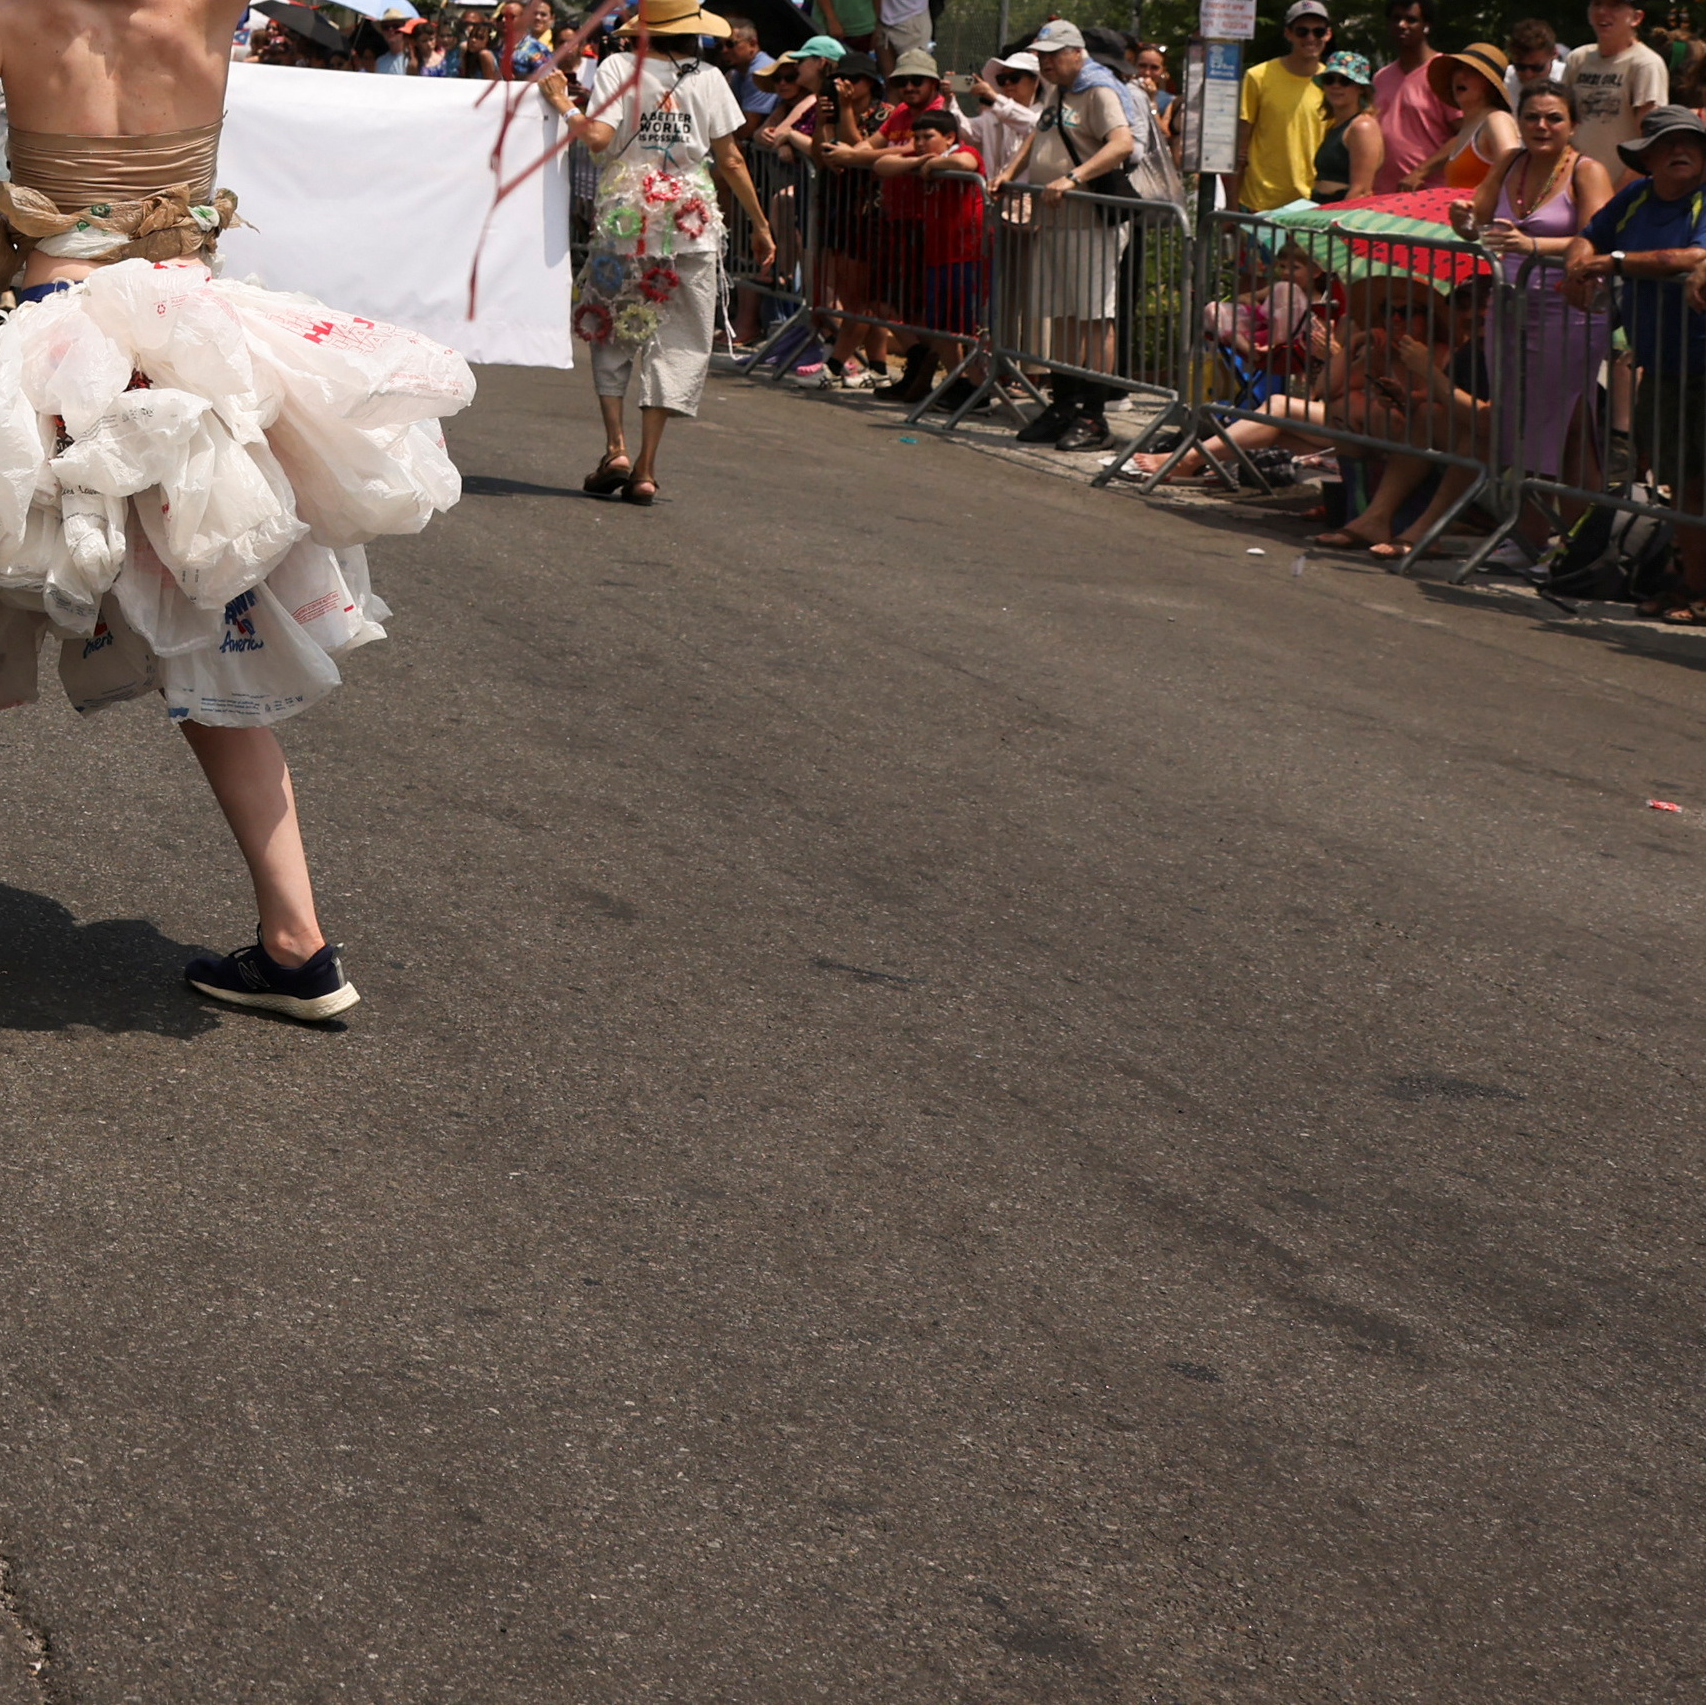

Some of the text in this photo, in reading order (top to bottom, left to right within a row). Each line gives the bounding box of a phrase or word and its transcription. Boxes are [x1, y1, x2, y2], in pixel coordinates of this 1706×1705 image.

[650, 111, 691, 123] BETTER
[640, 123, 691, 134] WORLD
[648, 134, 690, 143] POSSIBLE
